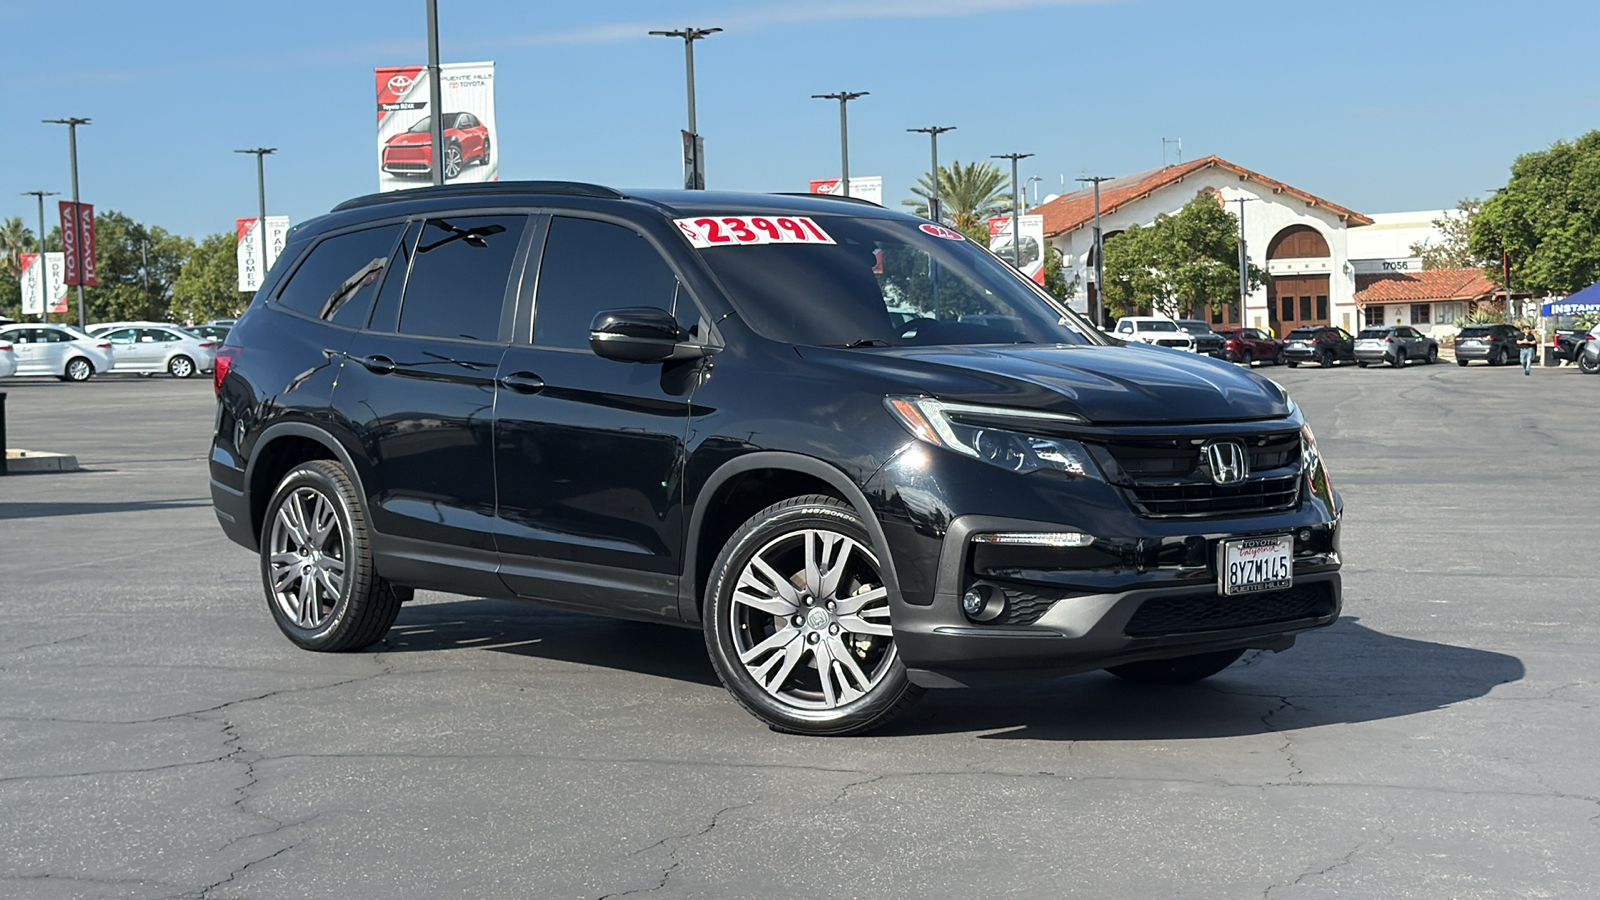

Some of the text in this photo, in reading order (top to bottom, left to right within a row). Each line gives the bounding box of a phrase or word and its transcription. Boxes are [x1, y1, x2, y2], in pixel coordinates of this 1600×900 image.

[460, 80, 486, 88] TOYOTA
[382, 103, 400, 111] Toyota
[63, 206, 76, 279] TOYOTA
[82, 208, 95, 281] TOYOTA
[245, 230, 256, 287] CUSTOMER
[1382, 261, 1409, 270] 17056
[52, 263, 61, 300] DRIVE
[1551, 303, 1600, 315] INSTANT
[1244, 539, 1278, 548] TOYOTA
[1230, 556, 1288, 586] 8YZM145
